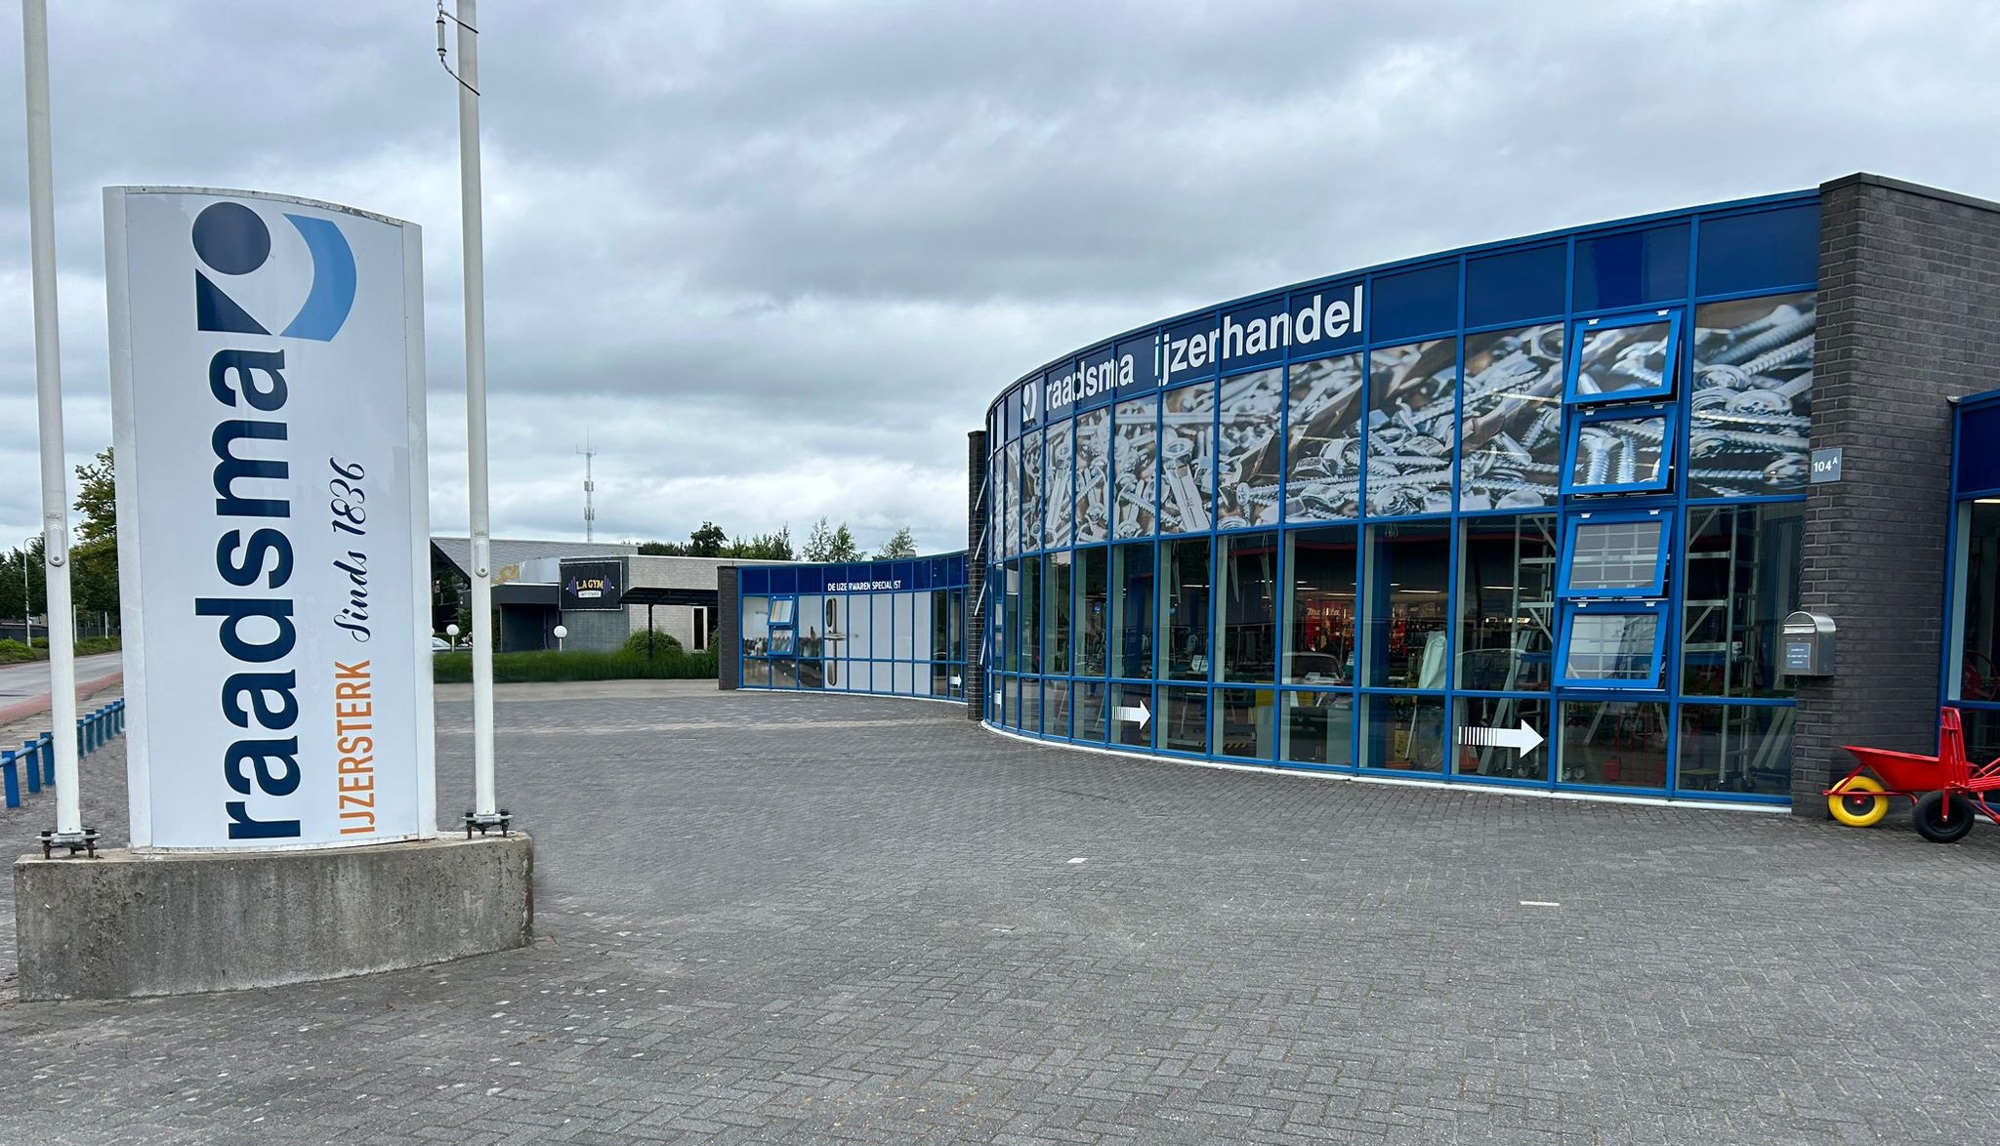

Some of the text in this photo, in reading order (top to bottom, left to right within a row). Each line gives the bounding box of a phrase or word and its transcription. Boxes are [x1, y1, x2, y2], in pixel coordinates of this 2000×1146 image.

[1046, 284, 1364, 412] raadsma ijzerhandel
[1813, 456, 1838, 473] 104A
[195, 348, 302, 840] raadsma
[587, 579, 604, 589] GYM
[827, 582, 836, 591] DE
[329, 456, 376, 836] IJZERSTERK Sinds 1836
